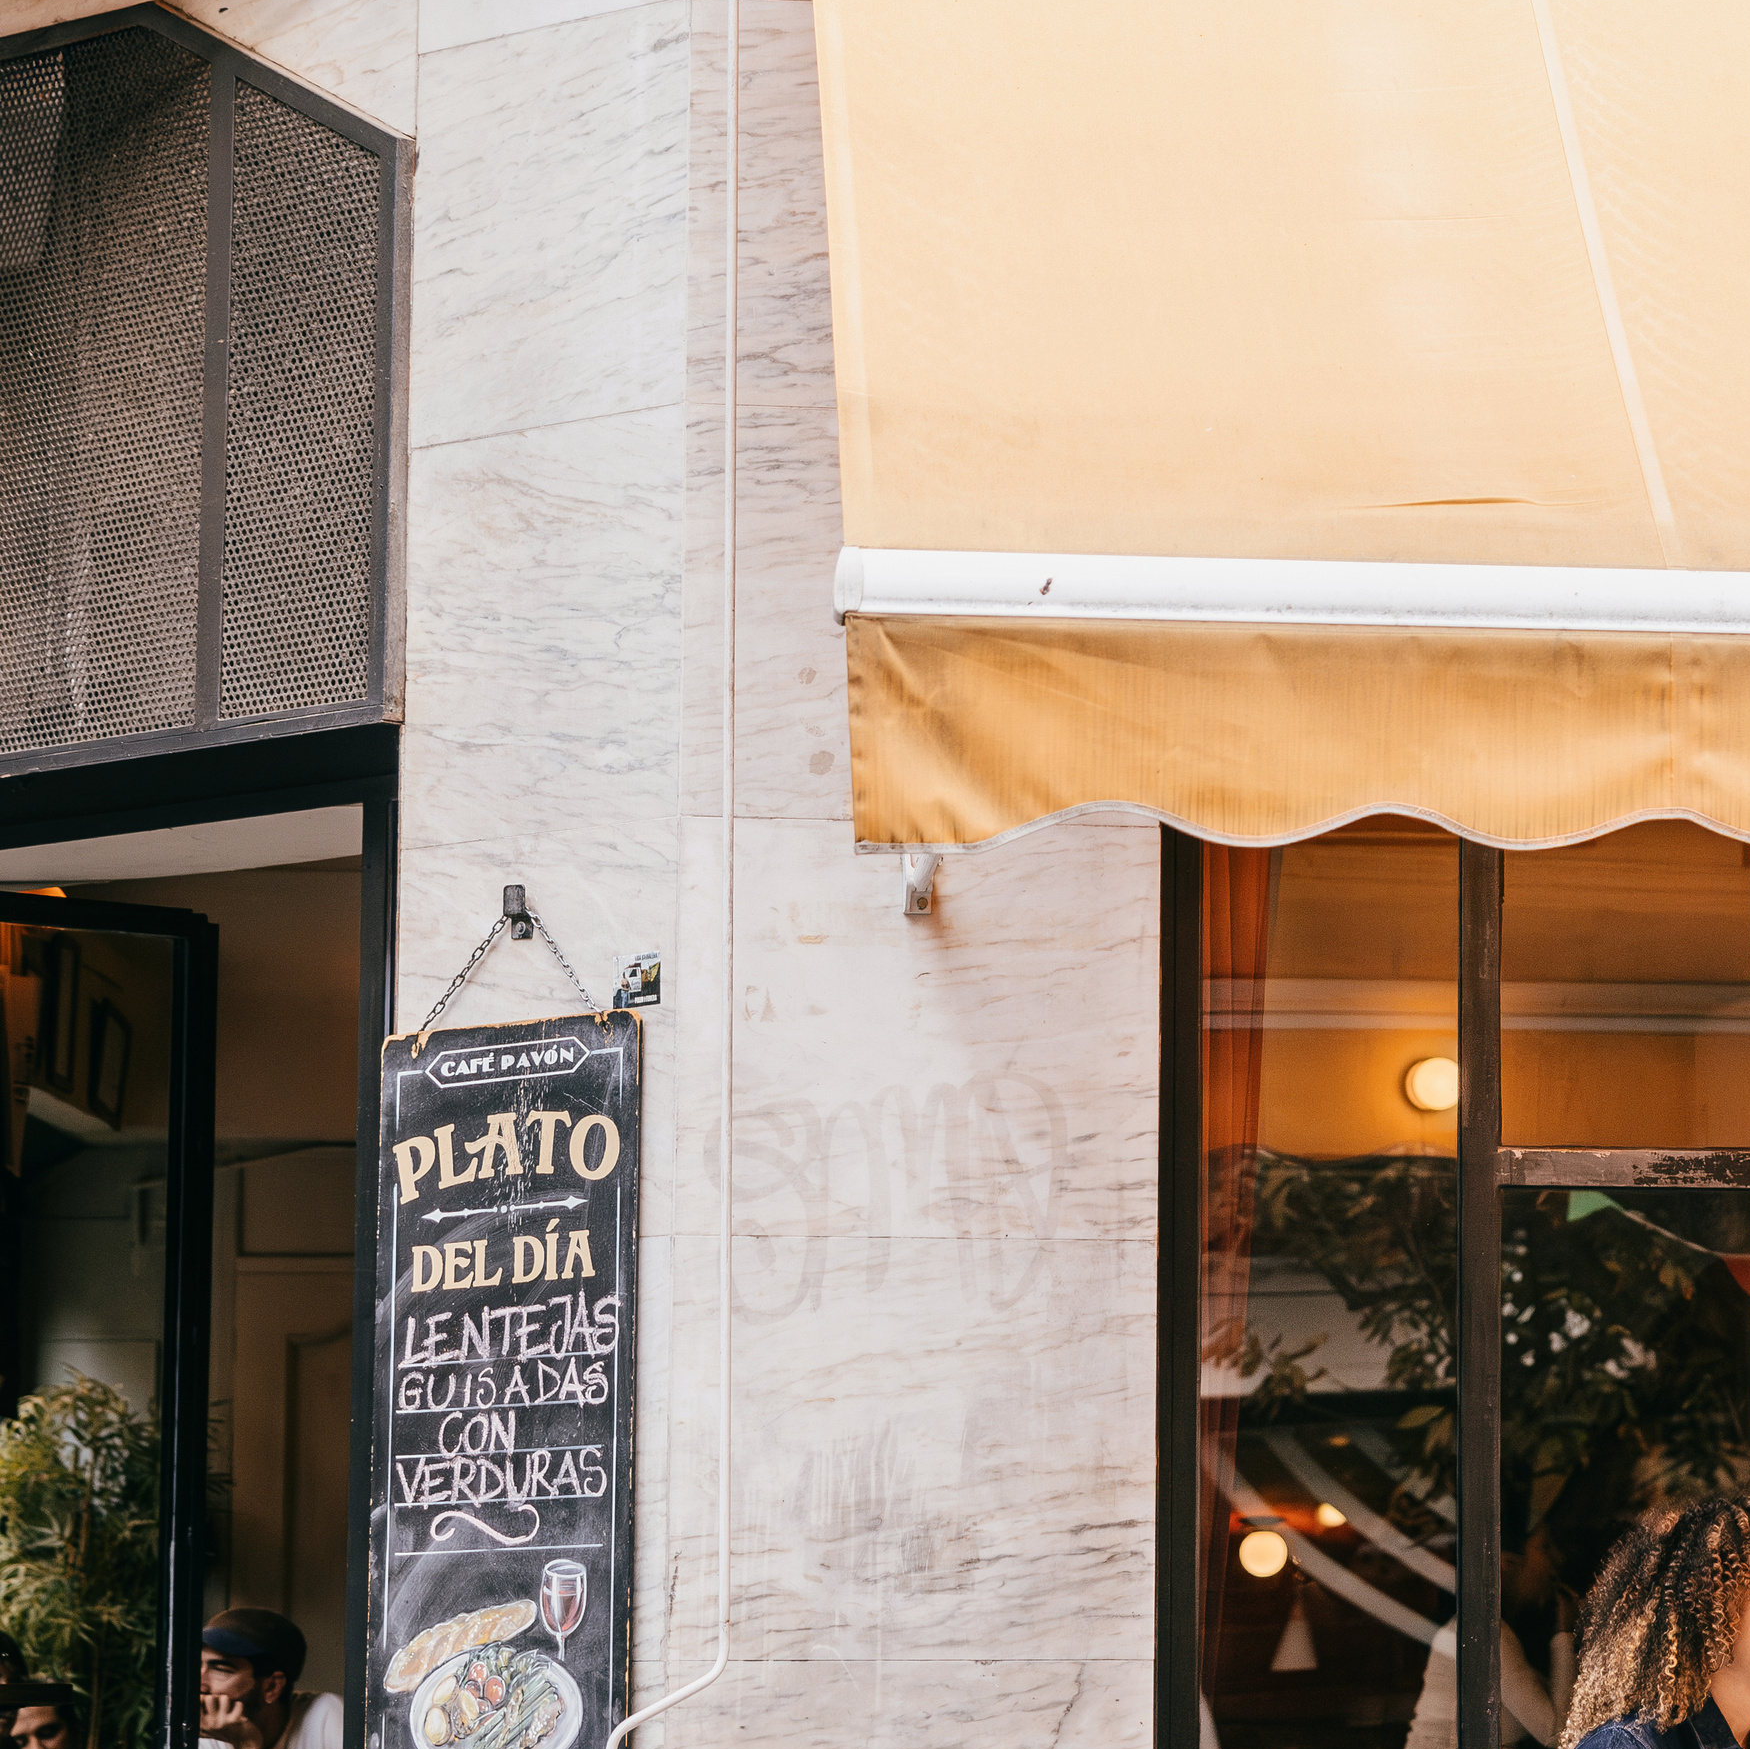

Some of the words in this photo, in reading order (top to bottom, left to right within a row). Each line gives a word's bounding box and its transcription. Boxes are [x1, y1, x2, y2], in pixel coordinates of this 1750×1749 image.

[440, 1052, 495, 1077] CAFÉ
[501, 1045, 575, 1071] PAVÓN
[392, 1110, 621, 1205] PLATO
[411, 1239, 503, 1293] DEL
[512, 1218, 596, 1285] DÍA
[398, 1288, 624, 1370] LENTEJAS
[398, 1356, 609, 1411] GUISADAS
[438, 1409, 516, 1459] CON
[395, 1446, 608, 1509] VERDURAS
